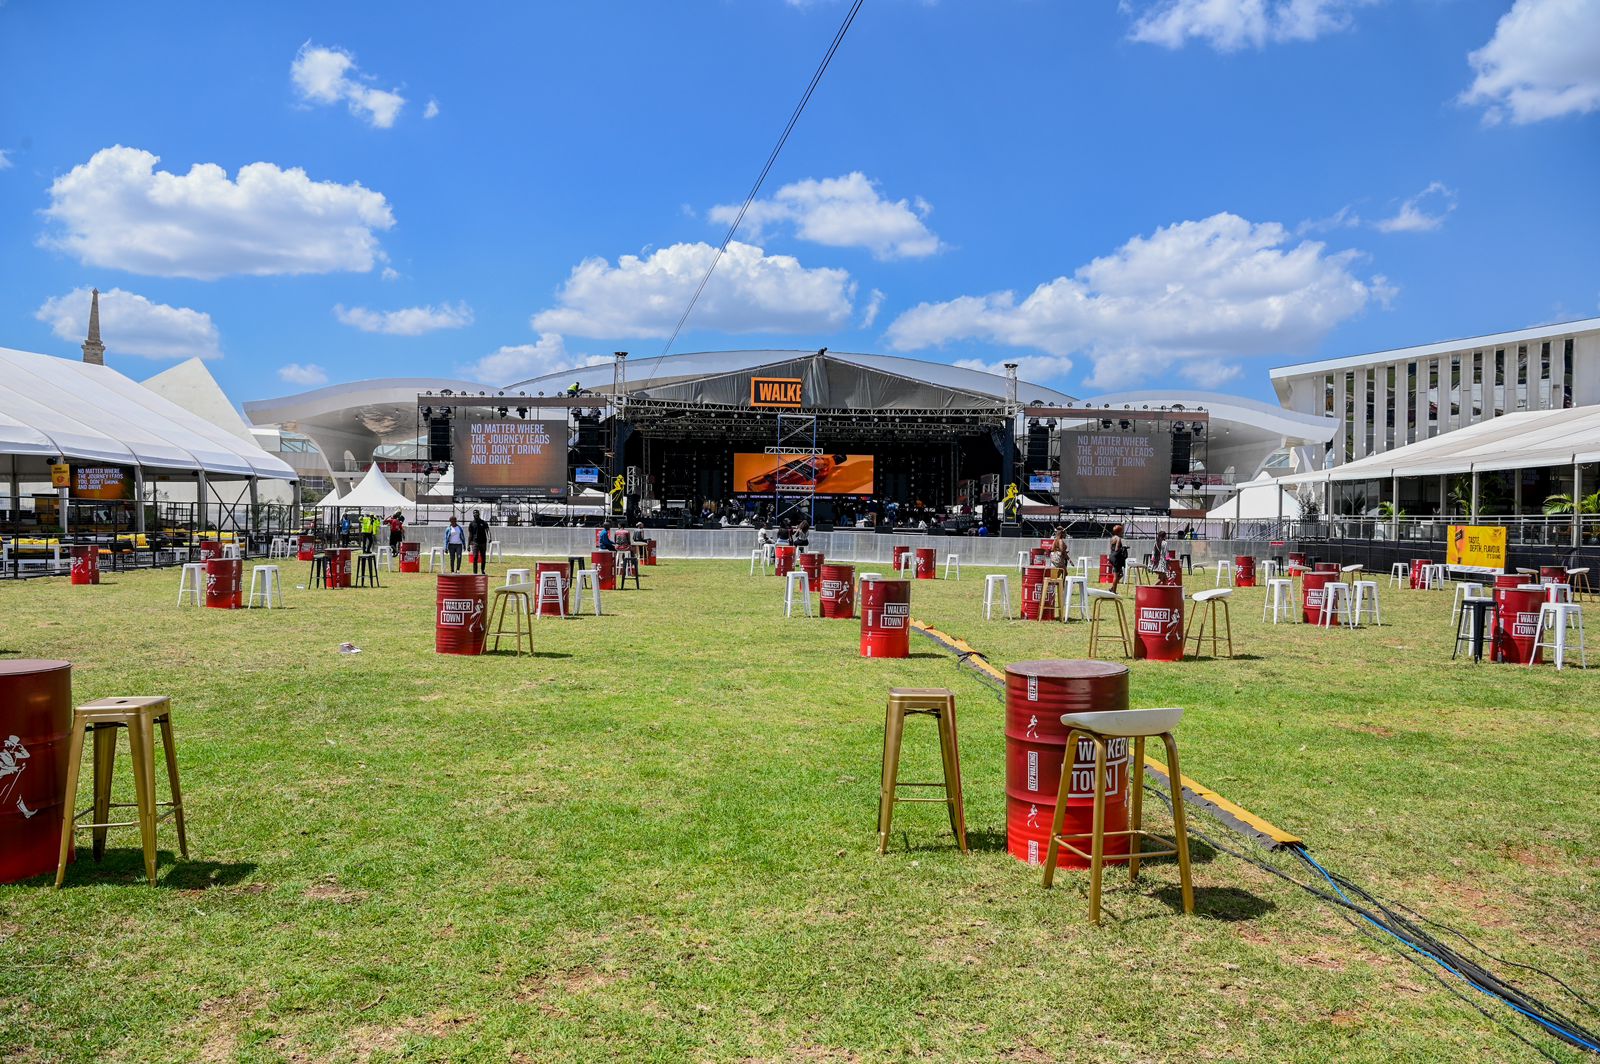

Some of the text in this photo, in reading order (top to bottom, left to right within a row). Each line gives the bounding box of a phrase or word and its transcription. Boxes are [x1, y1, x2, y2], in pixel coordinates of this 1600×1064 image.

[471, 424, 544, 434] NO MATTER WHERE
[471, 434, 550, 444] THE JOURNEY LEADS
[1078, 436, 1149, 446] NO MATTER WHERE
[492, 445, 515, 454] DON'T
[518, 445, 541, 454] DRINK
[1078, 446, 1154, 457] THE JOURNEY LEADS
[470, 455, 486, 464] AND
[1098, 456, 1120, 466] DON'T
[1122, 457, 1146, 467] DRINK
[1076, 466, 1092, 476] AND
[1484, 545, 1500, 554] FLAVOUR
[446, 602, 470, 610] WALKER
[443, 614, 461, 622] TOWN
[1144, 610, 1168, 620] WALKER
[1520, 614, 1540, 624] WALK
[884, 617, 902, 626] TOWN
[1140, 622, 1158, 630] TOWN
[1516, 626, 1536, 635] TOWN
[1078, 736, 1126, 762] WKER
